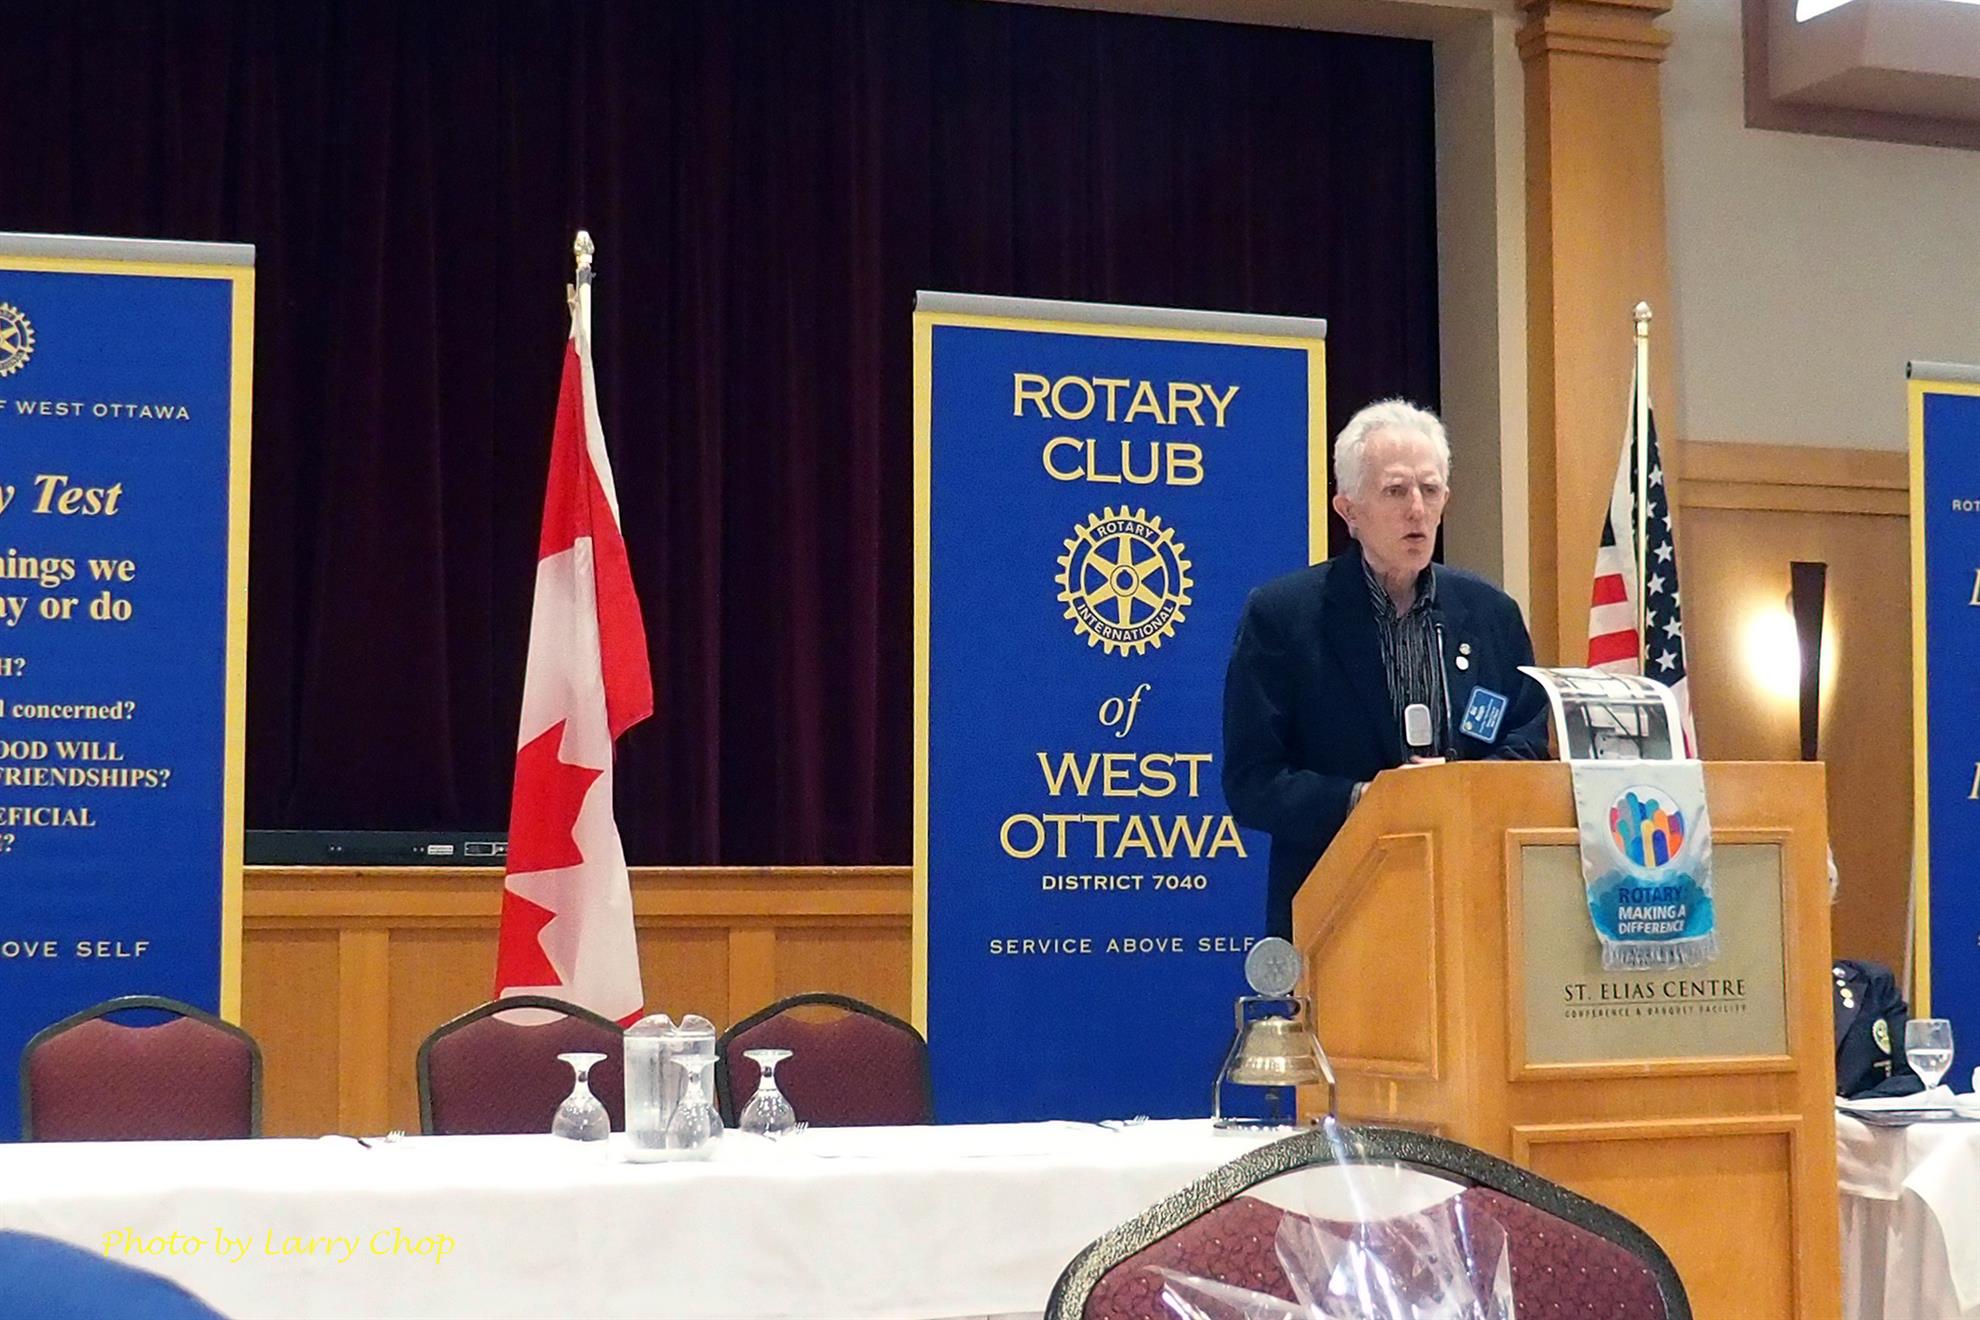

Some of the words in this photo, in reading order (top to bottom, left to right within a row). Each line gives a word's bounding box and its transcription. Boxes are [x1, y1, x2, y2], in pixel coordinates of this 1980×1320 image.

[16, 401, 84, 416] WEST
[93, 403, 190, 420] OTTAWA
[1013, 373, 1239, 427] ROTARY
[1042, 437, 1204, 485] CLUB
[32, 474, 123, 515] Test
[1097, 521, 1154, 539] ROTARY
[88, 559, 136, 581] we
[40, 597, 79, 619] or
[90, 590, 132, 621] do
[1077, 604, 1174, 641] INTERNATIONAL
[12, 701, 136, 720] concerned?
[1099, 683, 1151, 737] of
[56, 741, 124, 761] WILL
[1037, 752, 1212, 797] WEST
[1000, 814, 1247, 858] OTTAWA
[1042, 875, 1144, 890] DISTRICT
[1152, 875, 1207, 890] 7040
[1618, 887, 1682, 903] ROTARY
[1618, 905, 1676, 920] MAKING
[1678, 904, 1686, 918] A
[1618, 920, 1685, 934] DIFFERENCE
[76, 941, 149, 957] SELF
[990, 939, 1093, 954] SERVICE
[1106, 938, 1184, 953] ABOVE
[1198, 937, 1256, 952] SELF
[1564, 984, 1592, 1001] ST.
[1601, 982, 1655, 1000] ELIAS
[1663, 979, 1746, 998] CENTRE
